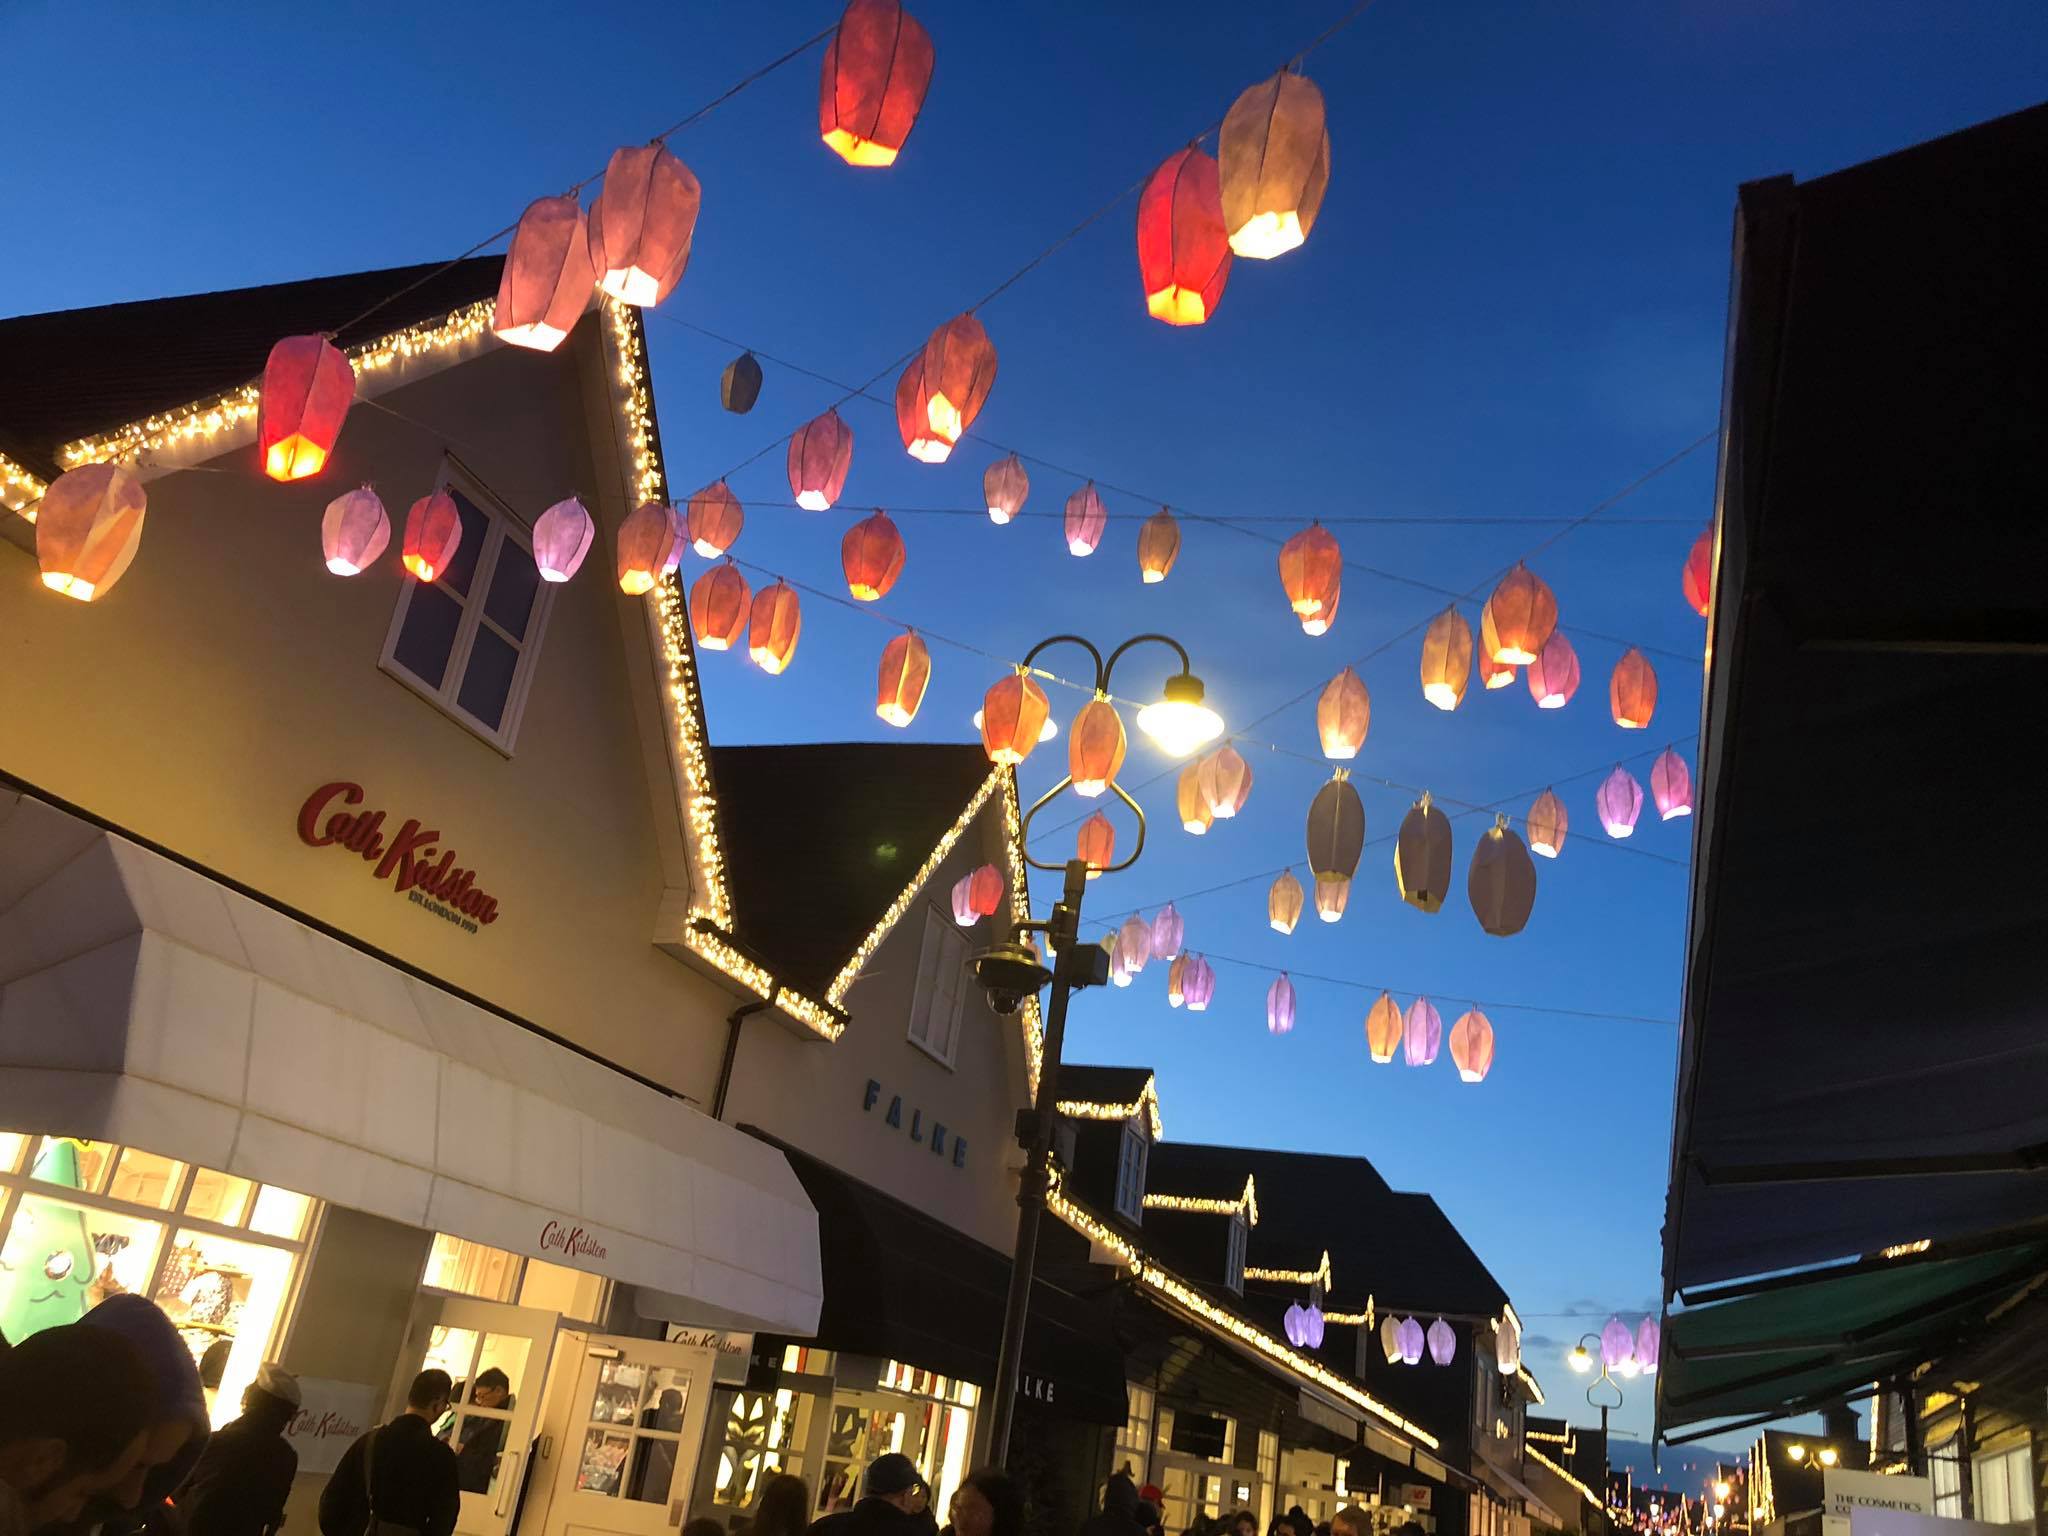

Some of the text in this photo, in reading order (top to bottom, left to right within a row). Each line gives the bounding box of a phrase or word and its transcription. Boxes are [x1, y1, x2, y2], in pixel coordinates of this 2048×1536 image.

[297, 782, 498, 925] Cath Kidston
[863, 1079, 968, 1169] FALKE
[541, 1221, 606, 1259] Cath Kidston
[701, 1333, 742, 1354] Kidston
[1015, 1375, 1054, 1402] LKE
[1835, 1494, 1922, 1513] THE COSMETICS
